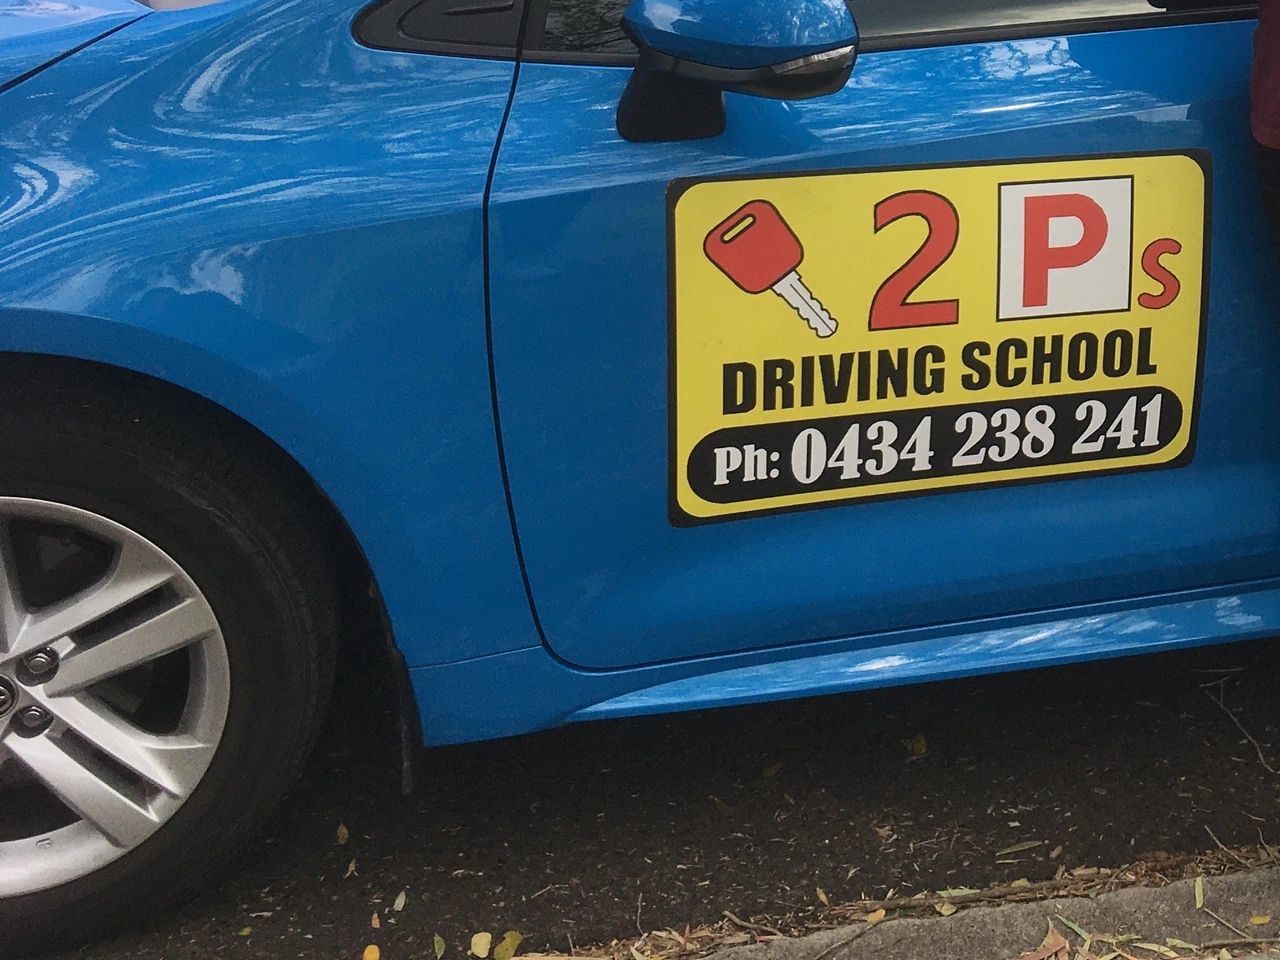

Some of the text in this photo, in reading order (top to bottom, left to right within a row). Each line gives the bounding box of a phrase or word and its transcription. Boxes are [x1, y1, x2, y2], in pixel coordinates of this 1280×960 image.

[868, 189, 960, 331] 2
[722, 327, 1157, 415] DRIVING SCHOOL
[713, 393, 1163, 487] Ph: 0434 238 241
